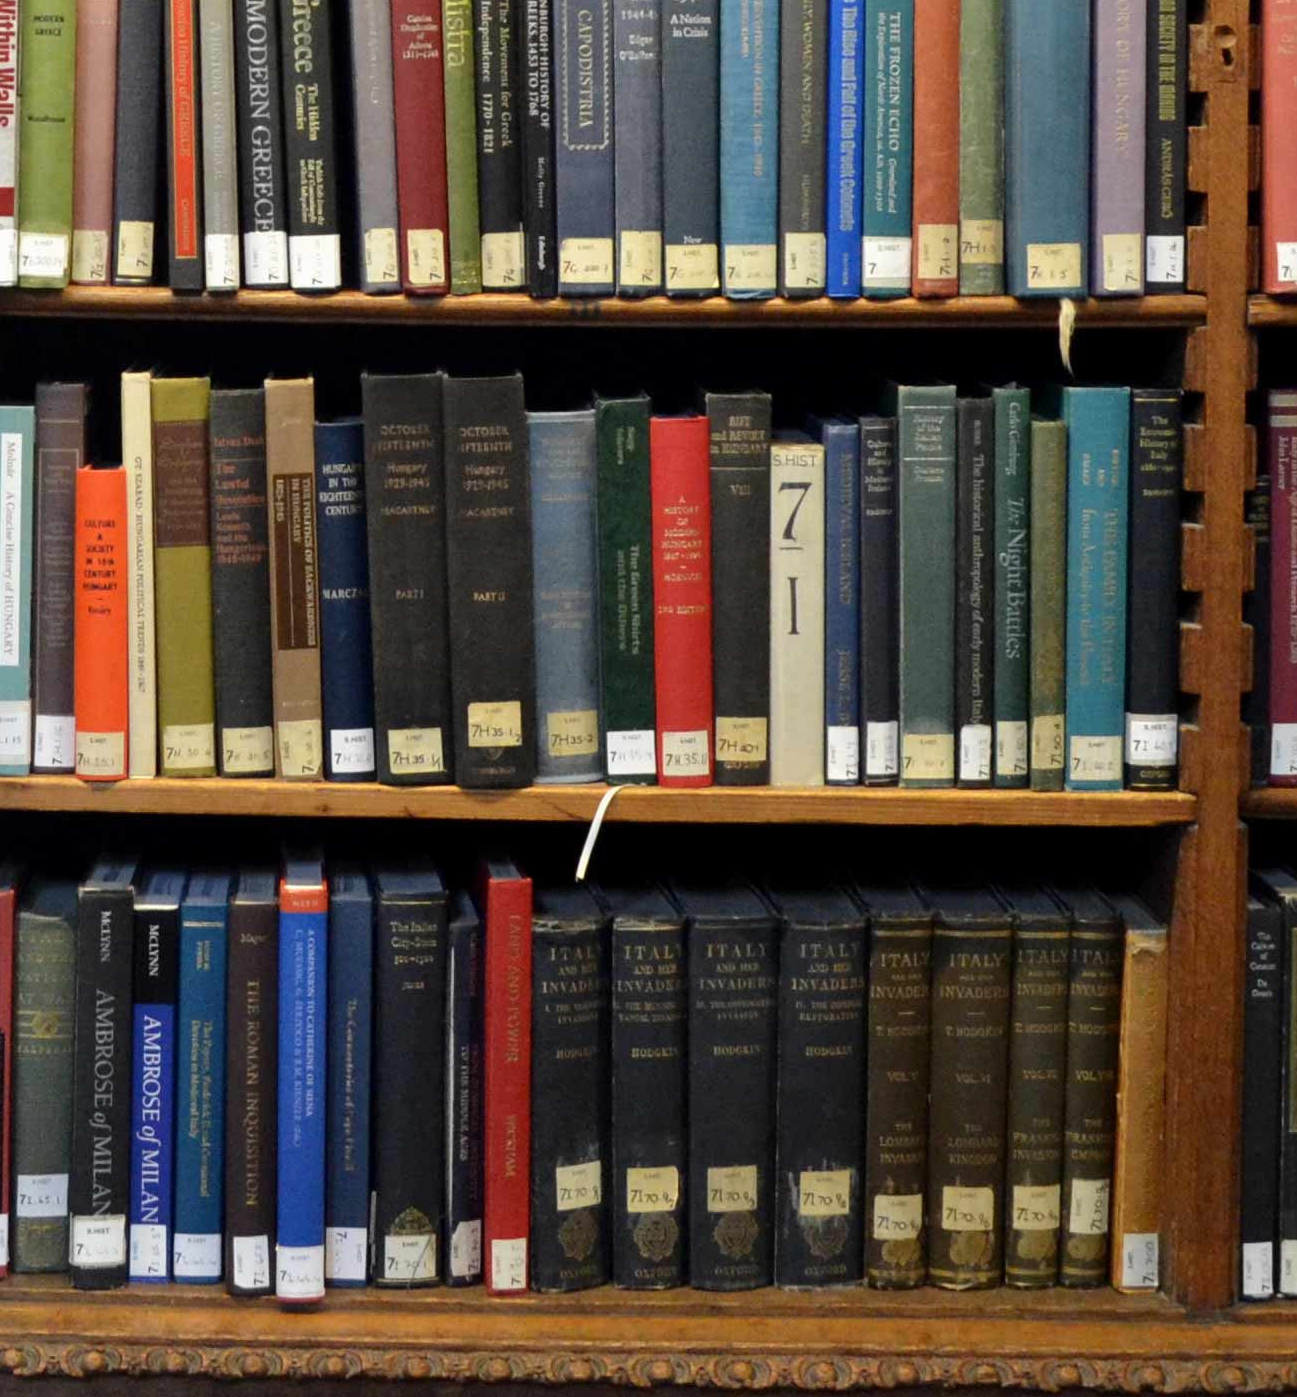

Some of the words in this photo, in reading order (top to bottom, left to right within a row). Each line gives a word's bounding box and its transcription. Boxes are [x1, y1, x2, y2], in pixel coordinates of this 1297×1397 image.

[578, 11, 594, 128] CAPODISTRIA
[250, 124, 274, 232] GREECE
[779, 483, 812, 541] 7
[999, 532, 1027, 591] Night
[1005, 593, 1028, 660] Battles
[95, 989, 115, 1107] AMBROSE
[144, 1015, 161, 1122] AMBROSE
[92, 1109, 113, 1133] of
[136, 1123, 160, 1148] of
[92, 1134, 114, 1217] MILAN
[141, 1149, 159, 1224] MILAN
